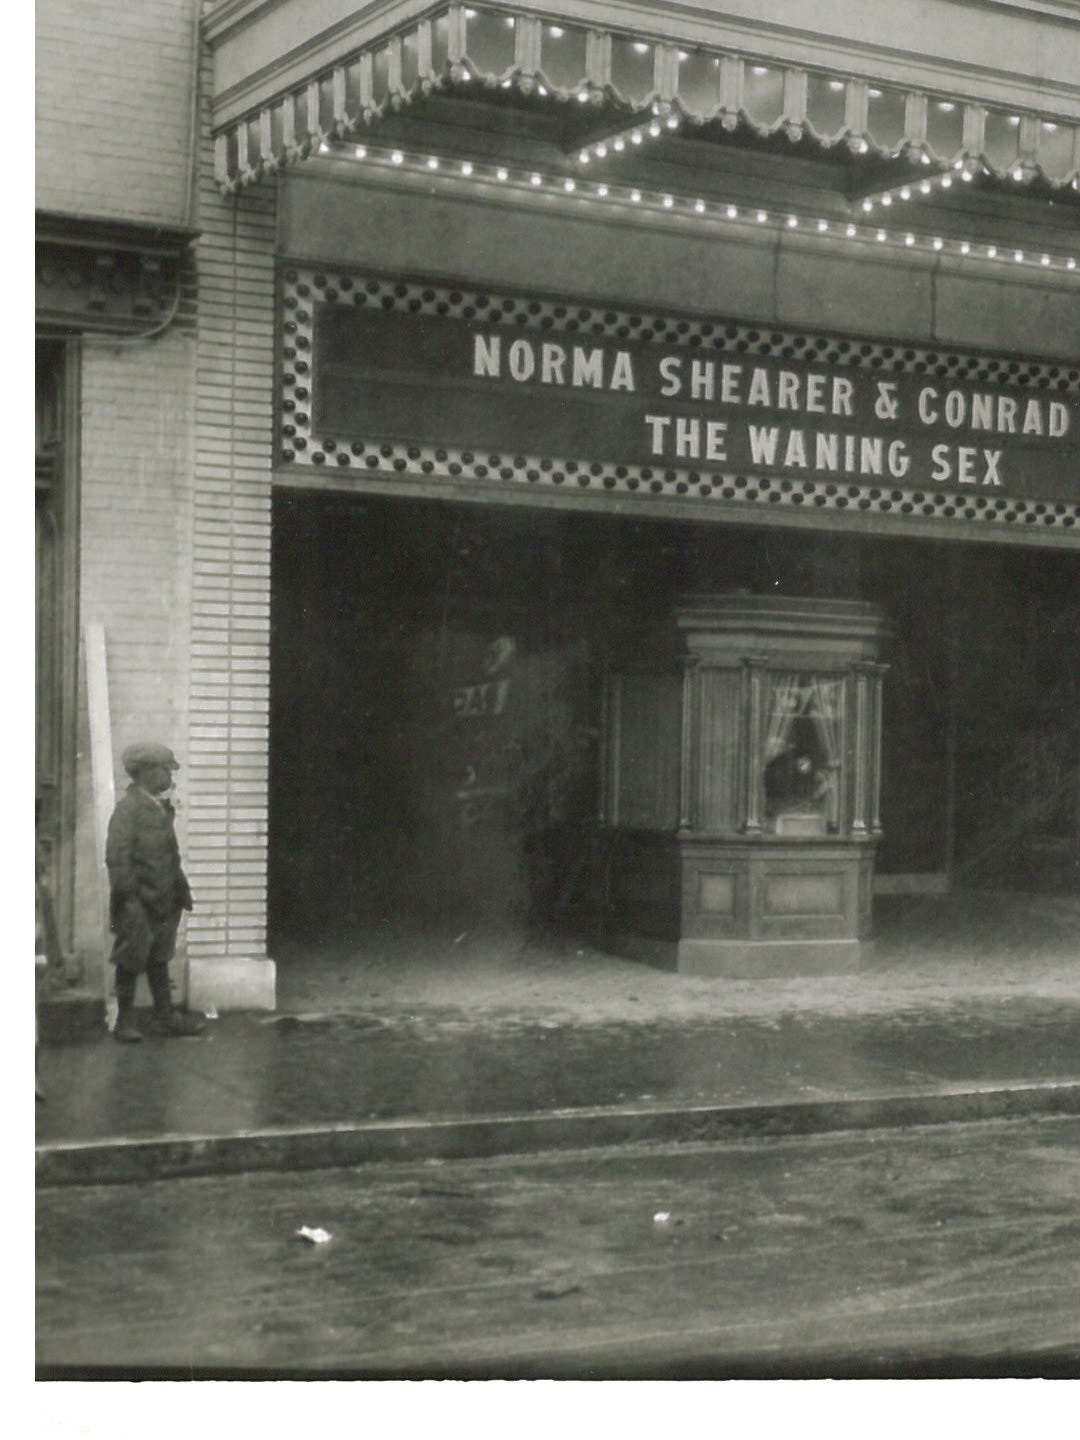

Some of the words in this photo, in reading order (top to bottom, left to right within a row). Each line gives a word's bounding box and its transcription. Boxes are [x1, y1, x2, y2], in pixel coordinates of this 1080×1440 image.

[474, 334, 636, 392] NORMA
[659, 356, 854, 417] SHEARER
[874, 381, 899, 420] &
[918, 386, 1070, 438] CONRAD
[645, 414, 728, 461] THE
[748, 424, 911, 479] WANING
[931, 443, 1003, 487] SEX
